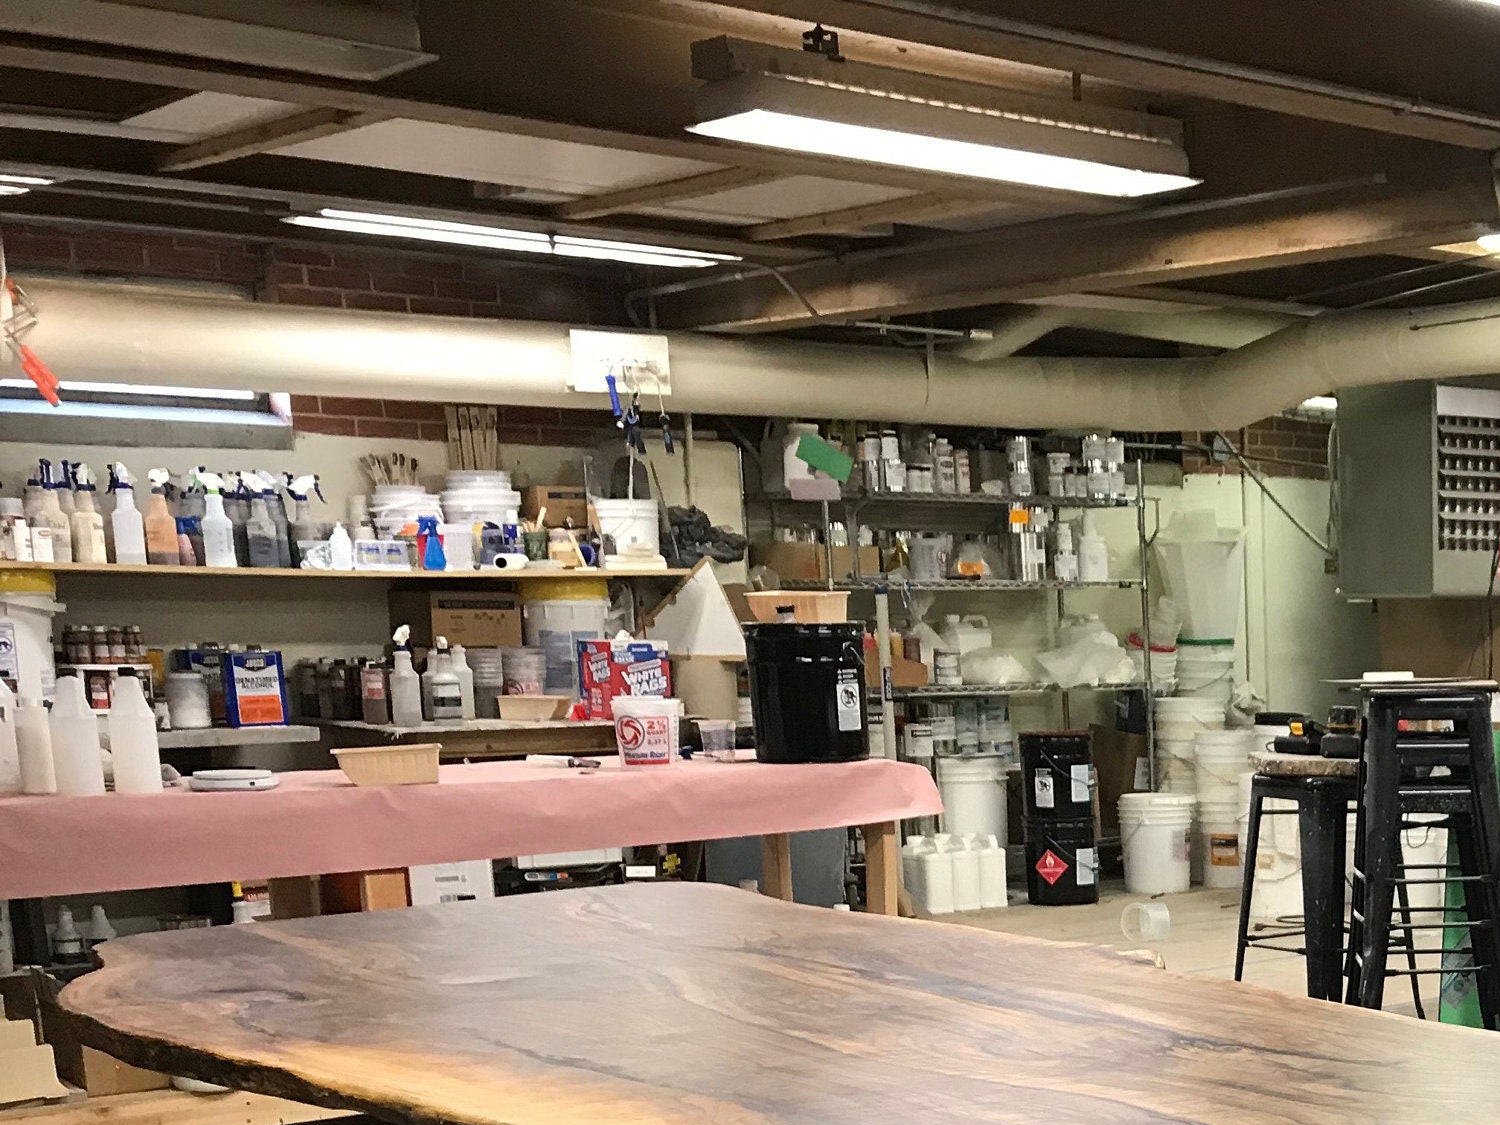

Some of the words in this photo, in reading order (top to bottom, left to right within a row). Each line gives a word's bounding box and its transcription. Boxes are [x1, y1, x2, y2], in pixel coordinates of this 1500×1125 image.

[236, 676, 278, 684] DENATURED
[621, 667, 662, 686] WHITE
[630, 676, 667, 697] RAGS
